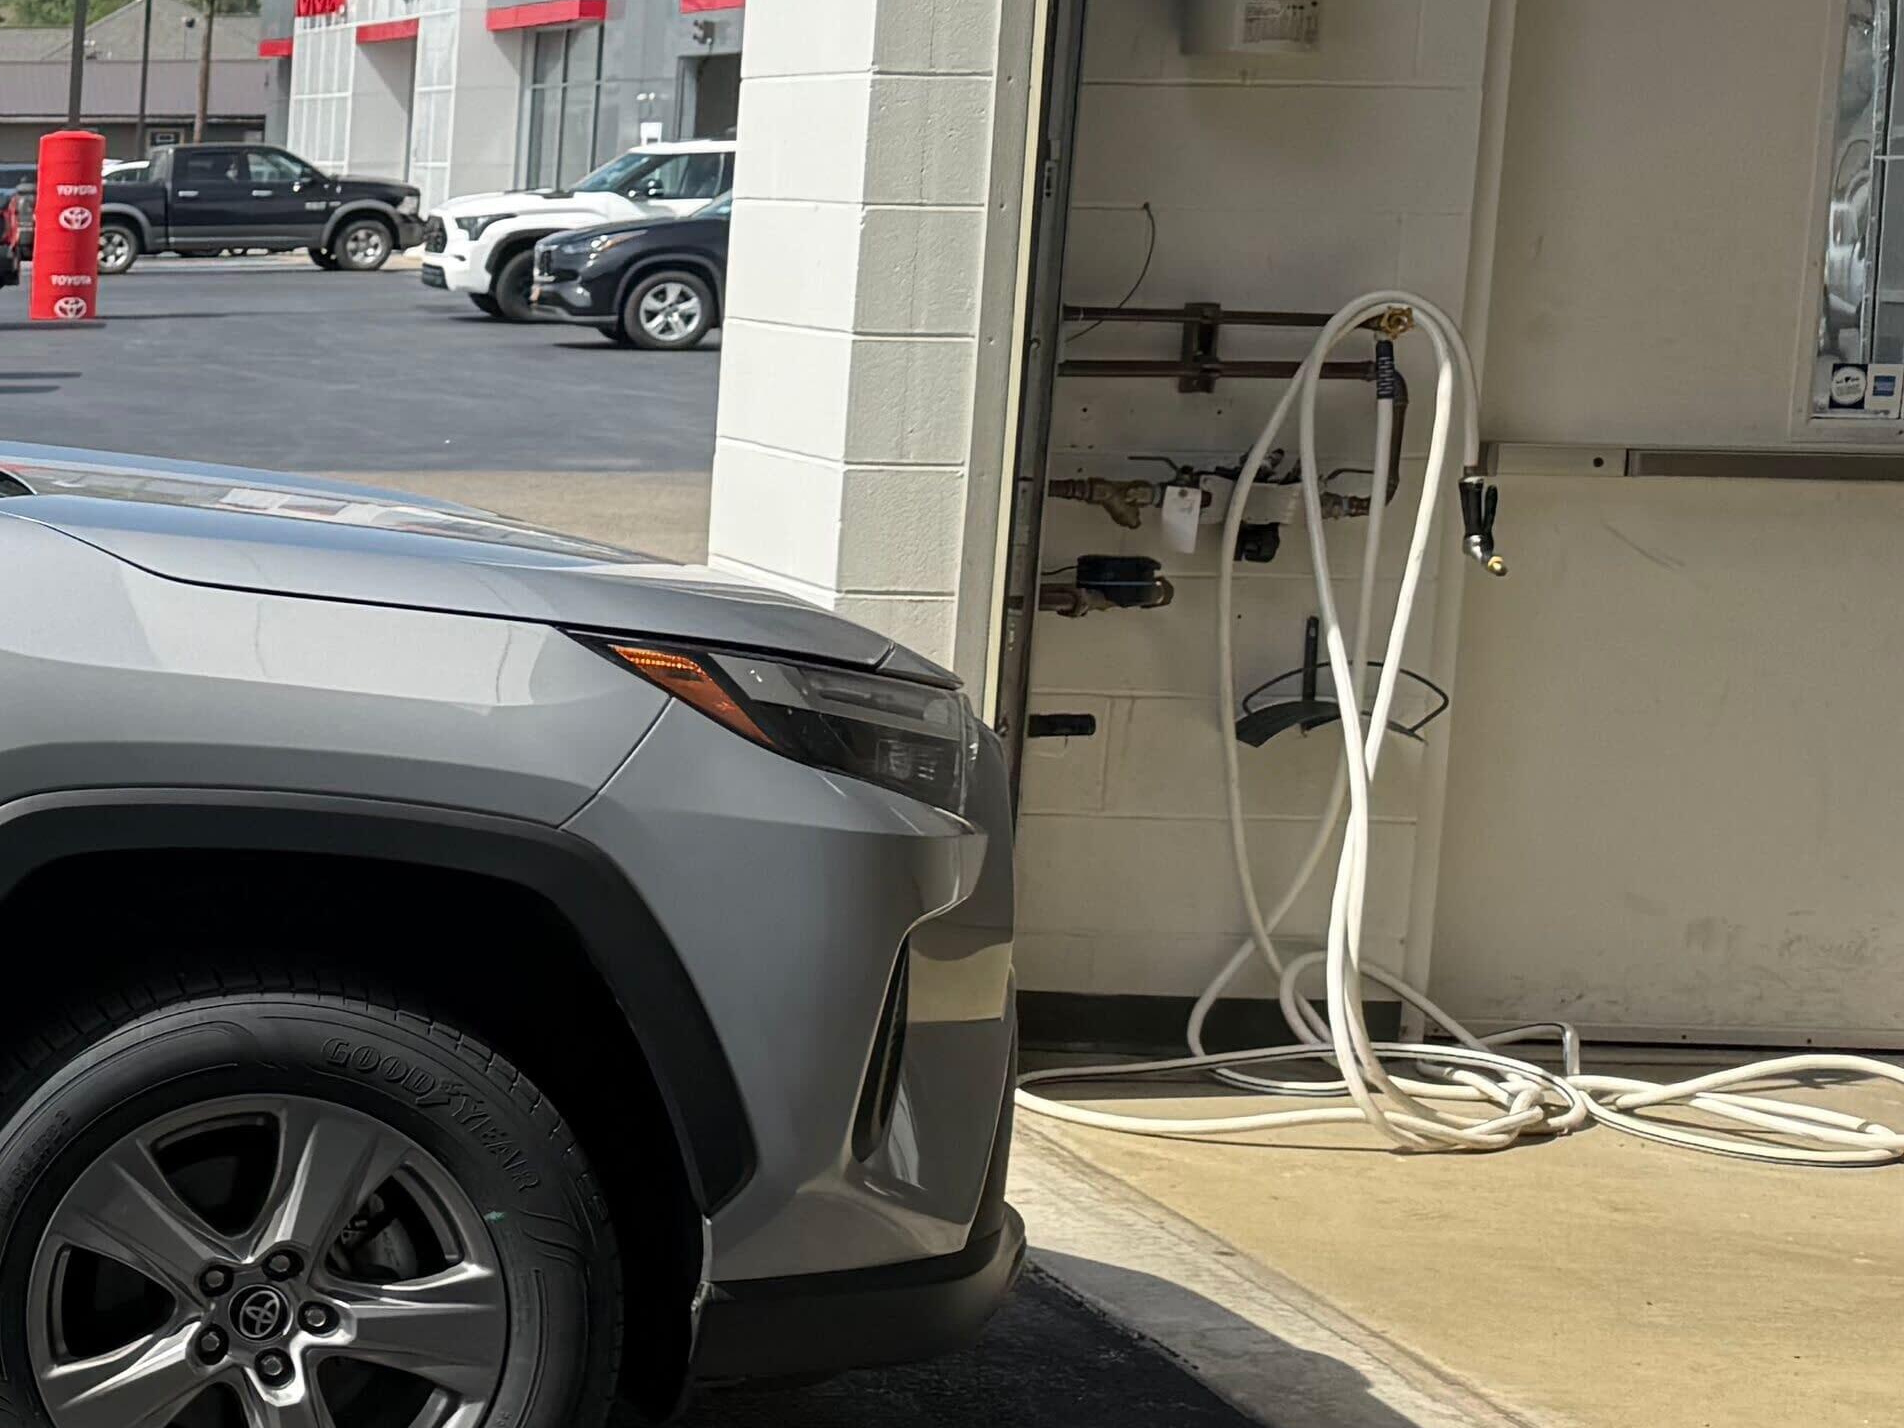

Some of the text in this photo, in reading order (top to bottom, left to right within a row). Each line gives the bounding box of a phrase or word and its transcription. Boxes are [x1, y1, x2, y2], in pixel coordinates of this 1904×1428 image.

[56, 184, 98, 196] TOYOTA
[50, 275, 92, 286] TOYOTA
[321, 1036, 541, 1193] GOODYEAR
